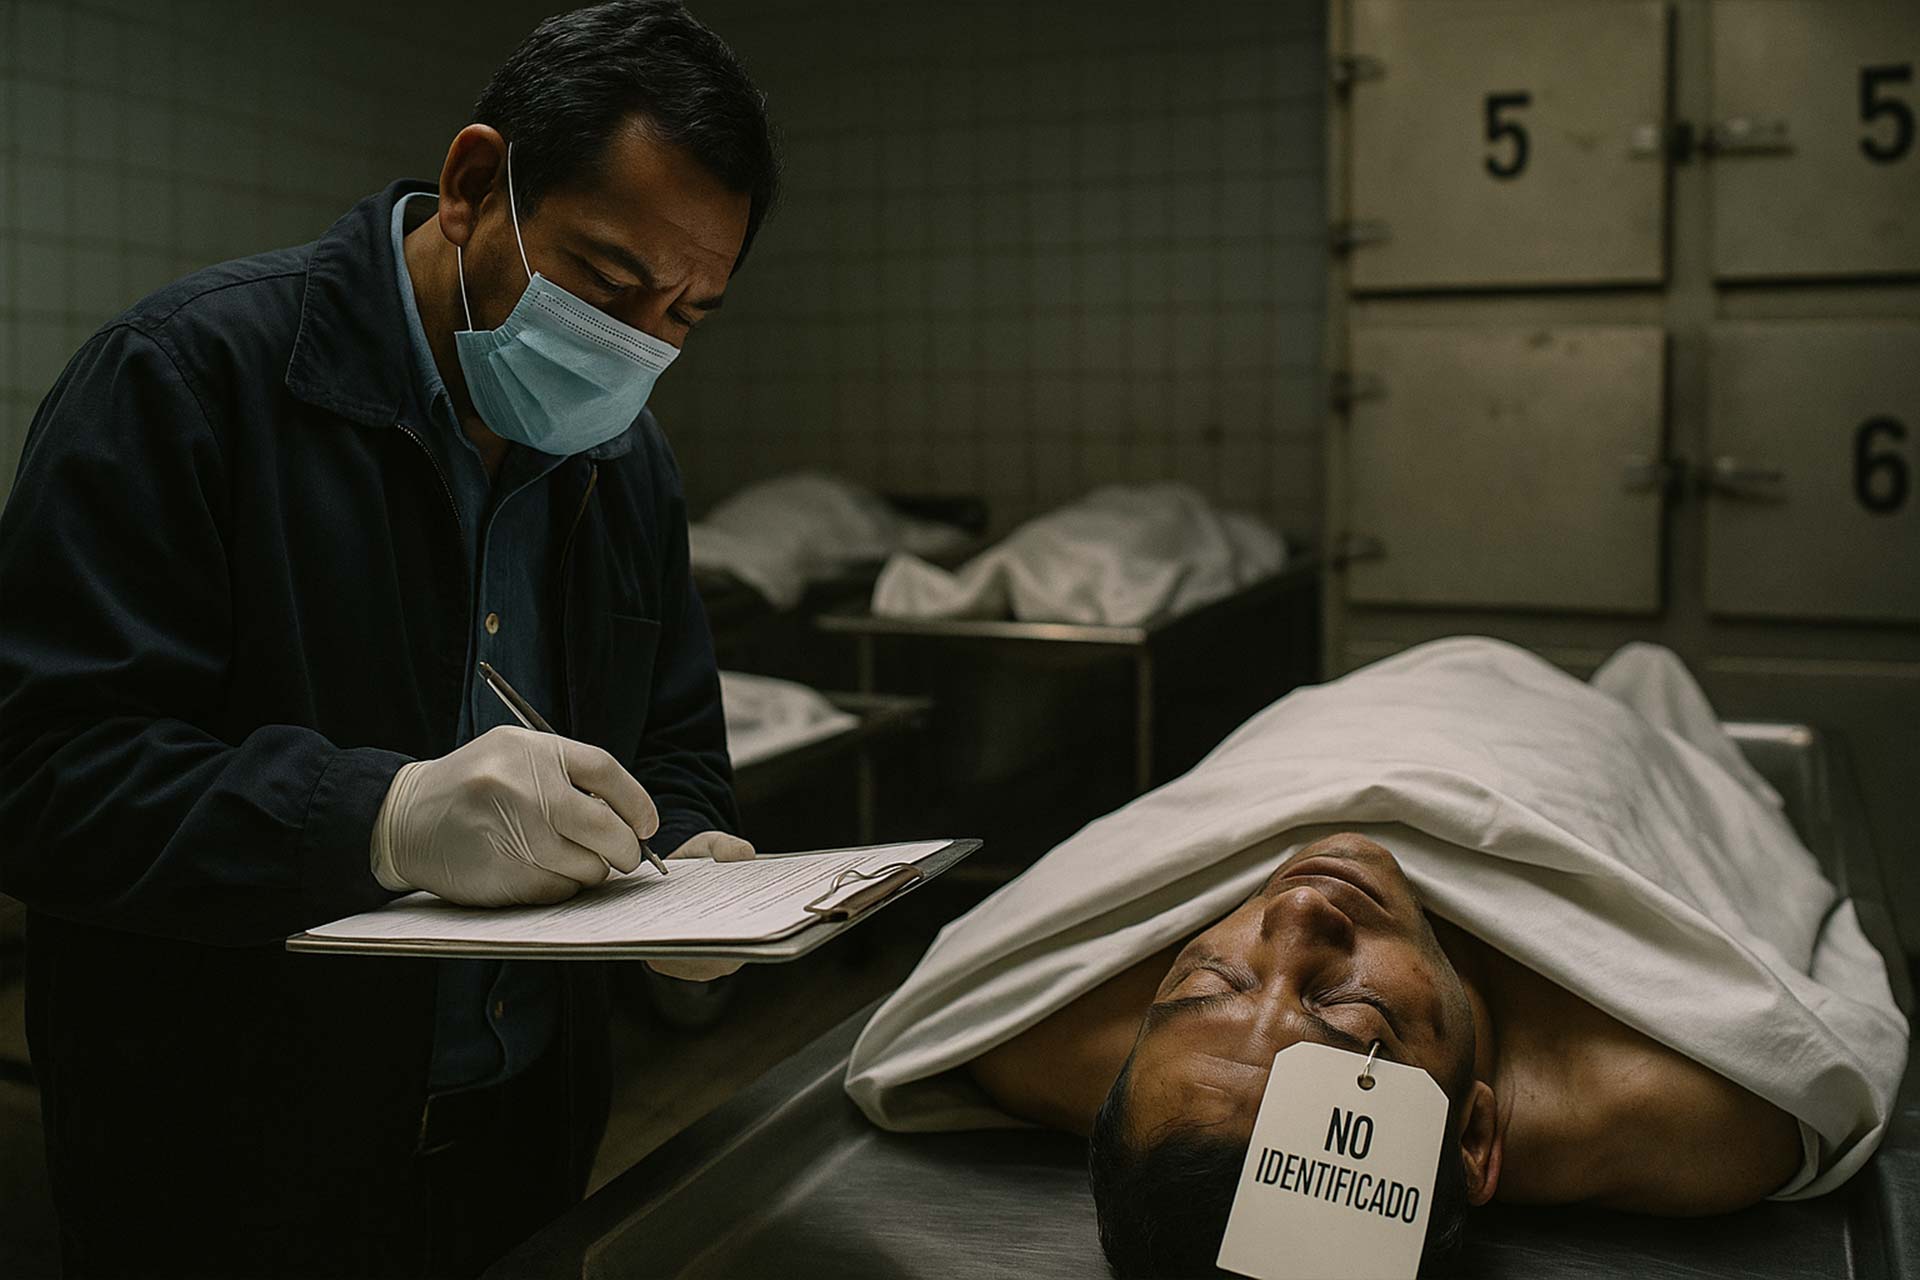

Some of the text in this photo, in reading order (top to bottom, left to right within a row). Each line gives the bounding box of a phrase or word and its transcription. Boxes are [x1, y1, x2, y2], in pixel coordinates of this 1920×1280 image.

[1483, 92, 1532, 180] 5
[1857, 65, 1915, 163] 5
[1852, 416, 1911, 514] 6
[1324, 1107, 1374, 1160] NO
[1255, 1148, 1420, 1223] IDENTIFICADO
